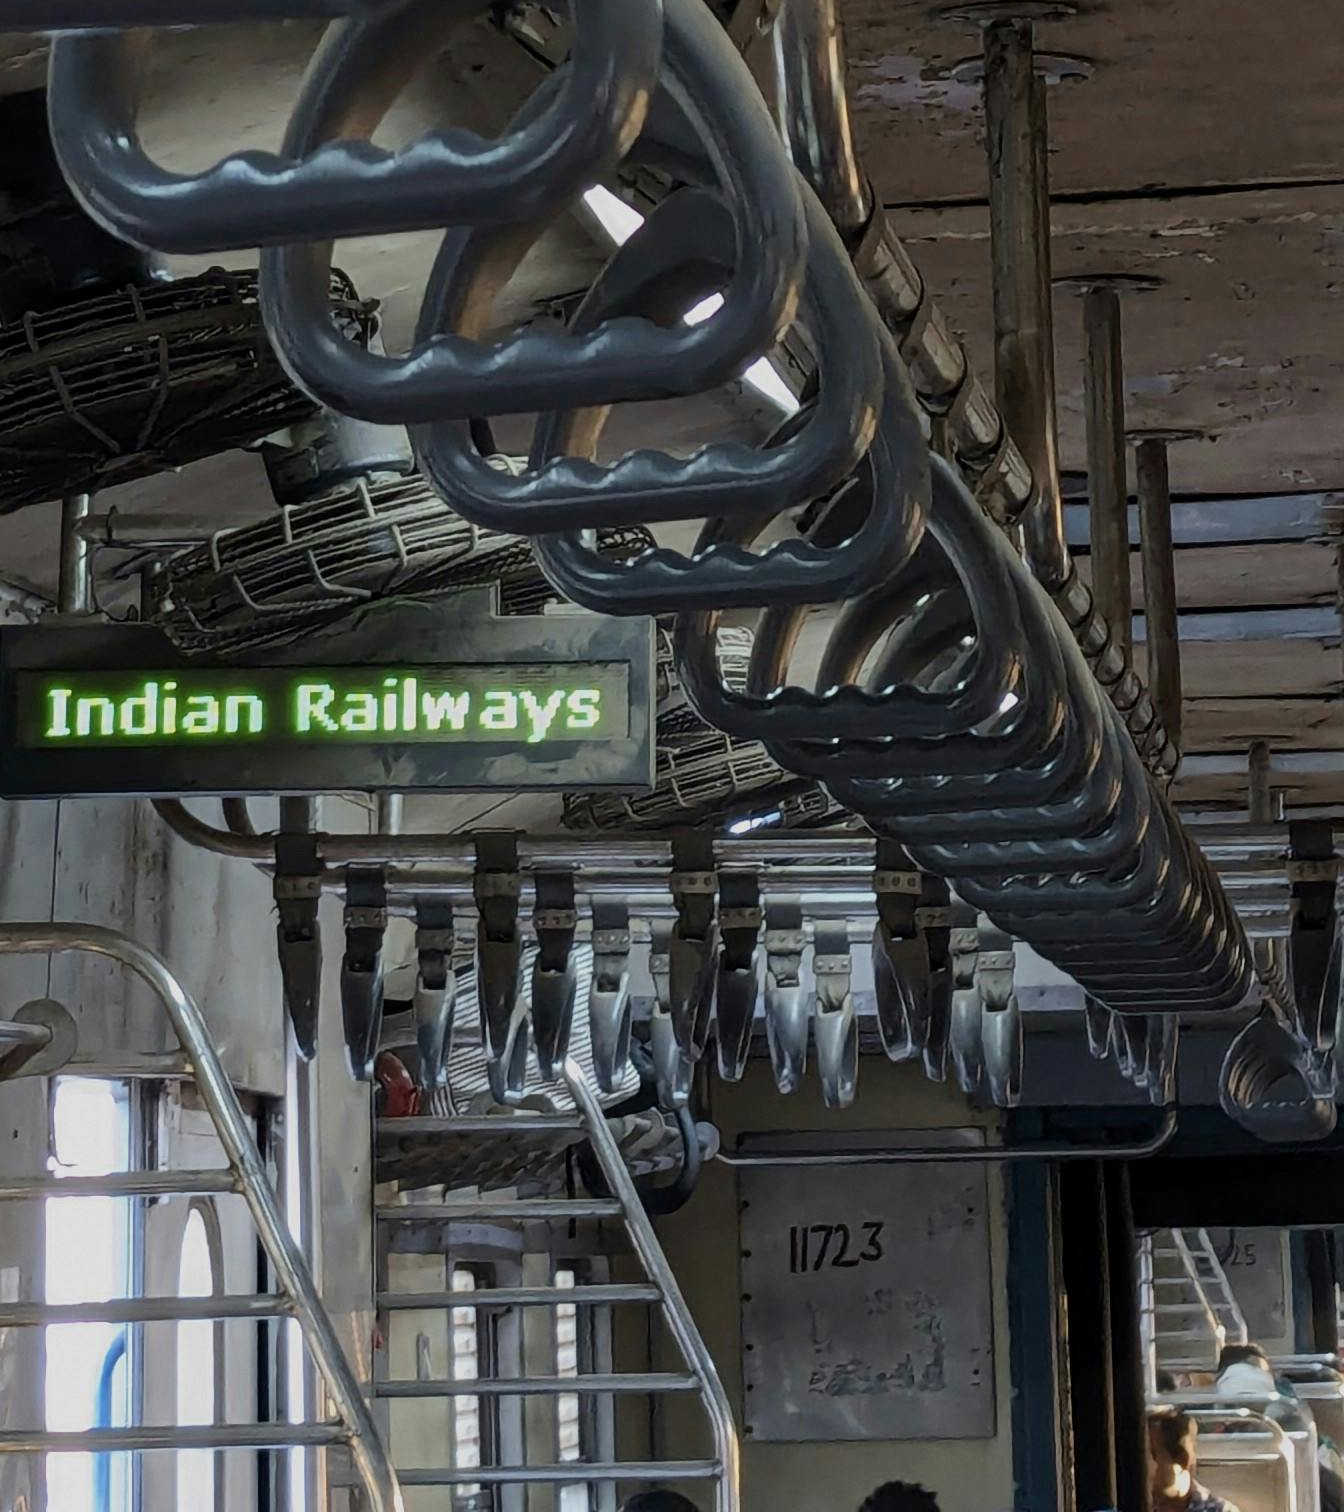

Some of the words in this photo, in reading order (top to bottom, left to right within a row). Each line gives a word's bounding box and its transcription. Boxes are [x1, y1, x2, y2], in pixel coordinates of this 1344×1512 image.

[45, 681, 264, 737] Indian
[295, 676, 602, 743] Railways
[789, 1221, 884, 1273] 11723
